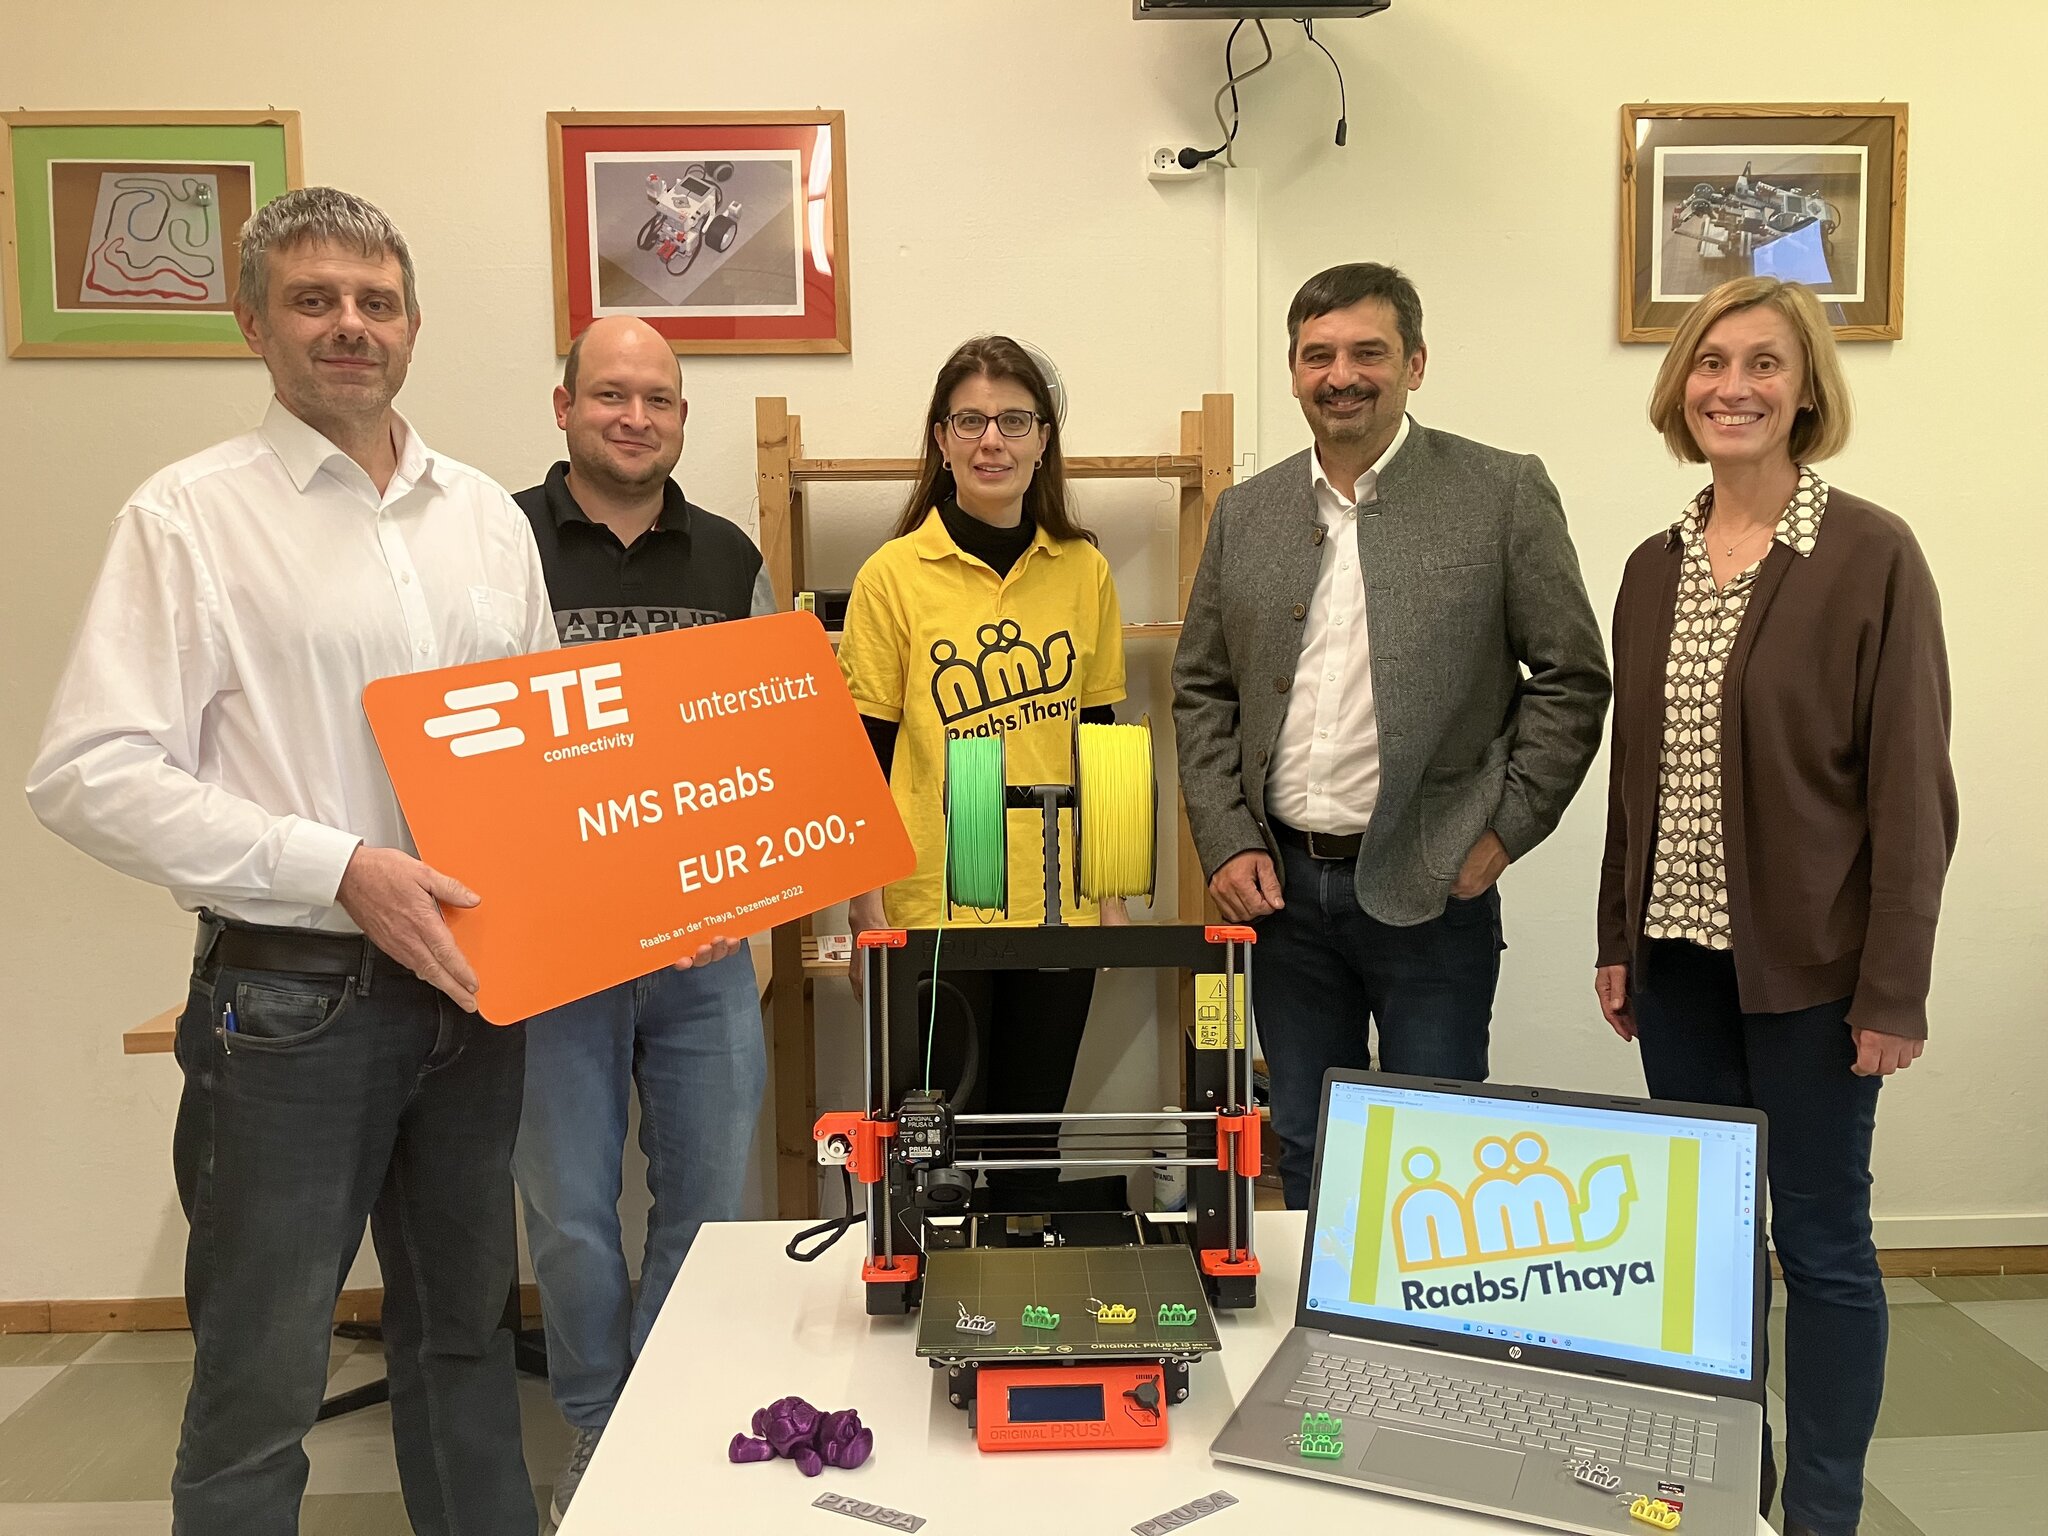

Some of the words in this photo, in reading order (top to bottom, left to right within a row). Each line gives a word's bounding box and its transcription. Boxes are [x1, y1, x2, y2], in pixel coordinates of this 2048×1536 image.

[530, 662, 629, 737] TE
[680, 672, 818, 724] unterstützt
[544, 732, 635, 763] connectivity
[577, 789, 663, 842] NMS
[673, 765, 776, 816] Raabs
[678, 844, 750, 894] EUR
[755, 814, 866, 868] 2.000,-
[639, 931, 671, 949] Raabs
[672, 927, 685, 938] an
[686, 921, 702, 933] der
[703, 911, 735, 927] Thaya,
[735, 895, 781, 915] Dezember
[781, 885, 804, 900] 2022
[1391, 1131, 1639, 1273] nms
[1401, 1260, 1655, 1310] Raabs/Thaya
[1510, 1346, 1521, 1358] hp
[990, 1429, 1048, 1440] ORIGINAL
[1050, 1422, 1115, 1439] PRUSA
[816, 1492, 917, 1530] PRUSA
[1134, 1492, 1232, 1536] PRUSA
